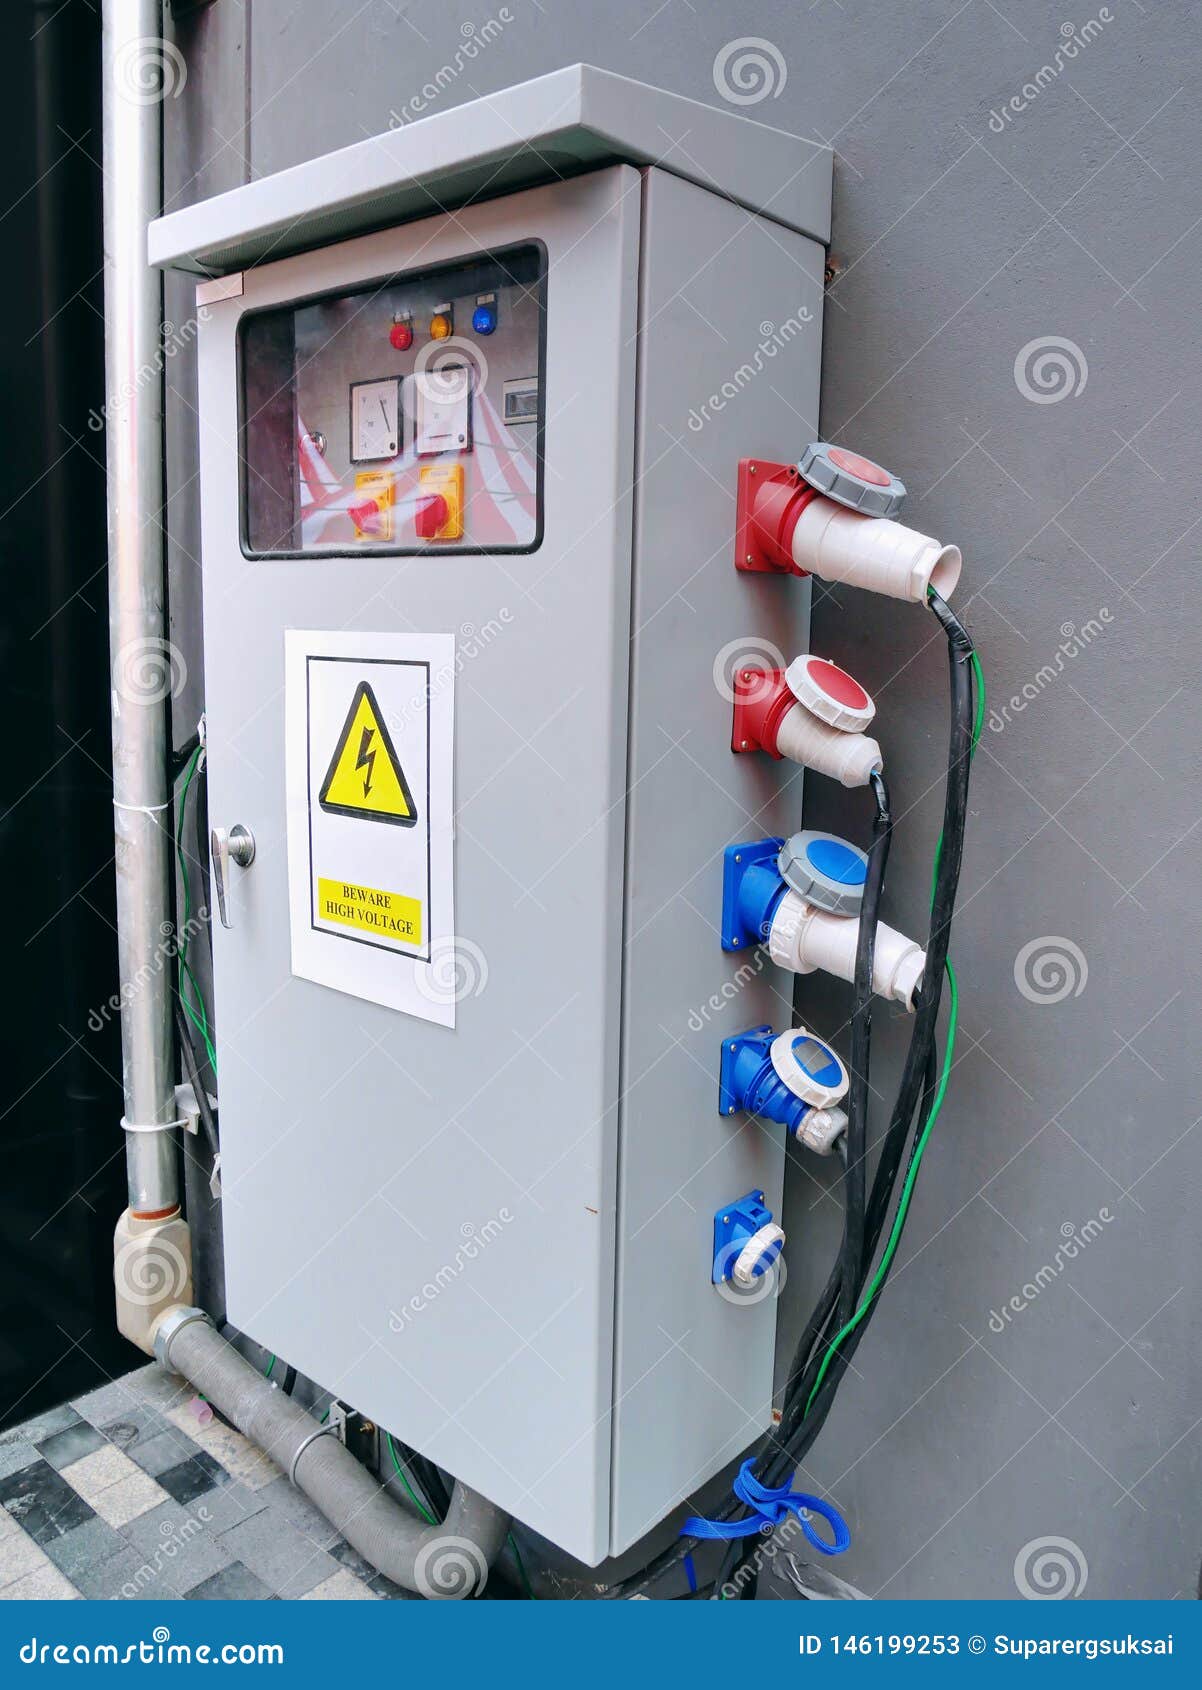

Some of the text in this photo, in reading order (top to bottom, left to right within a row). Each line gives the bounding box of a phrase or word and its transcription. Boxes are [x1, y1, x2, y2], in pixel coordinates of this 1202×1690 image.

[342, 885, 391, 909] BEWARE
[326, 900, 413, 935] HIGH VOLTAGE
